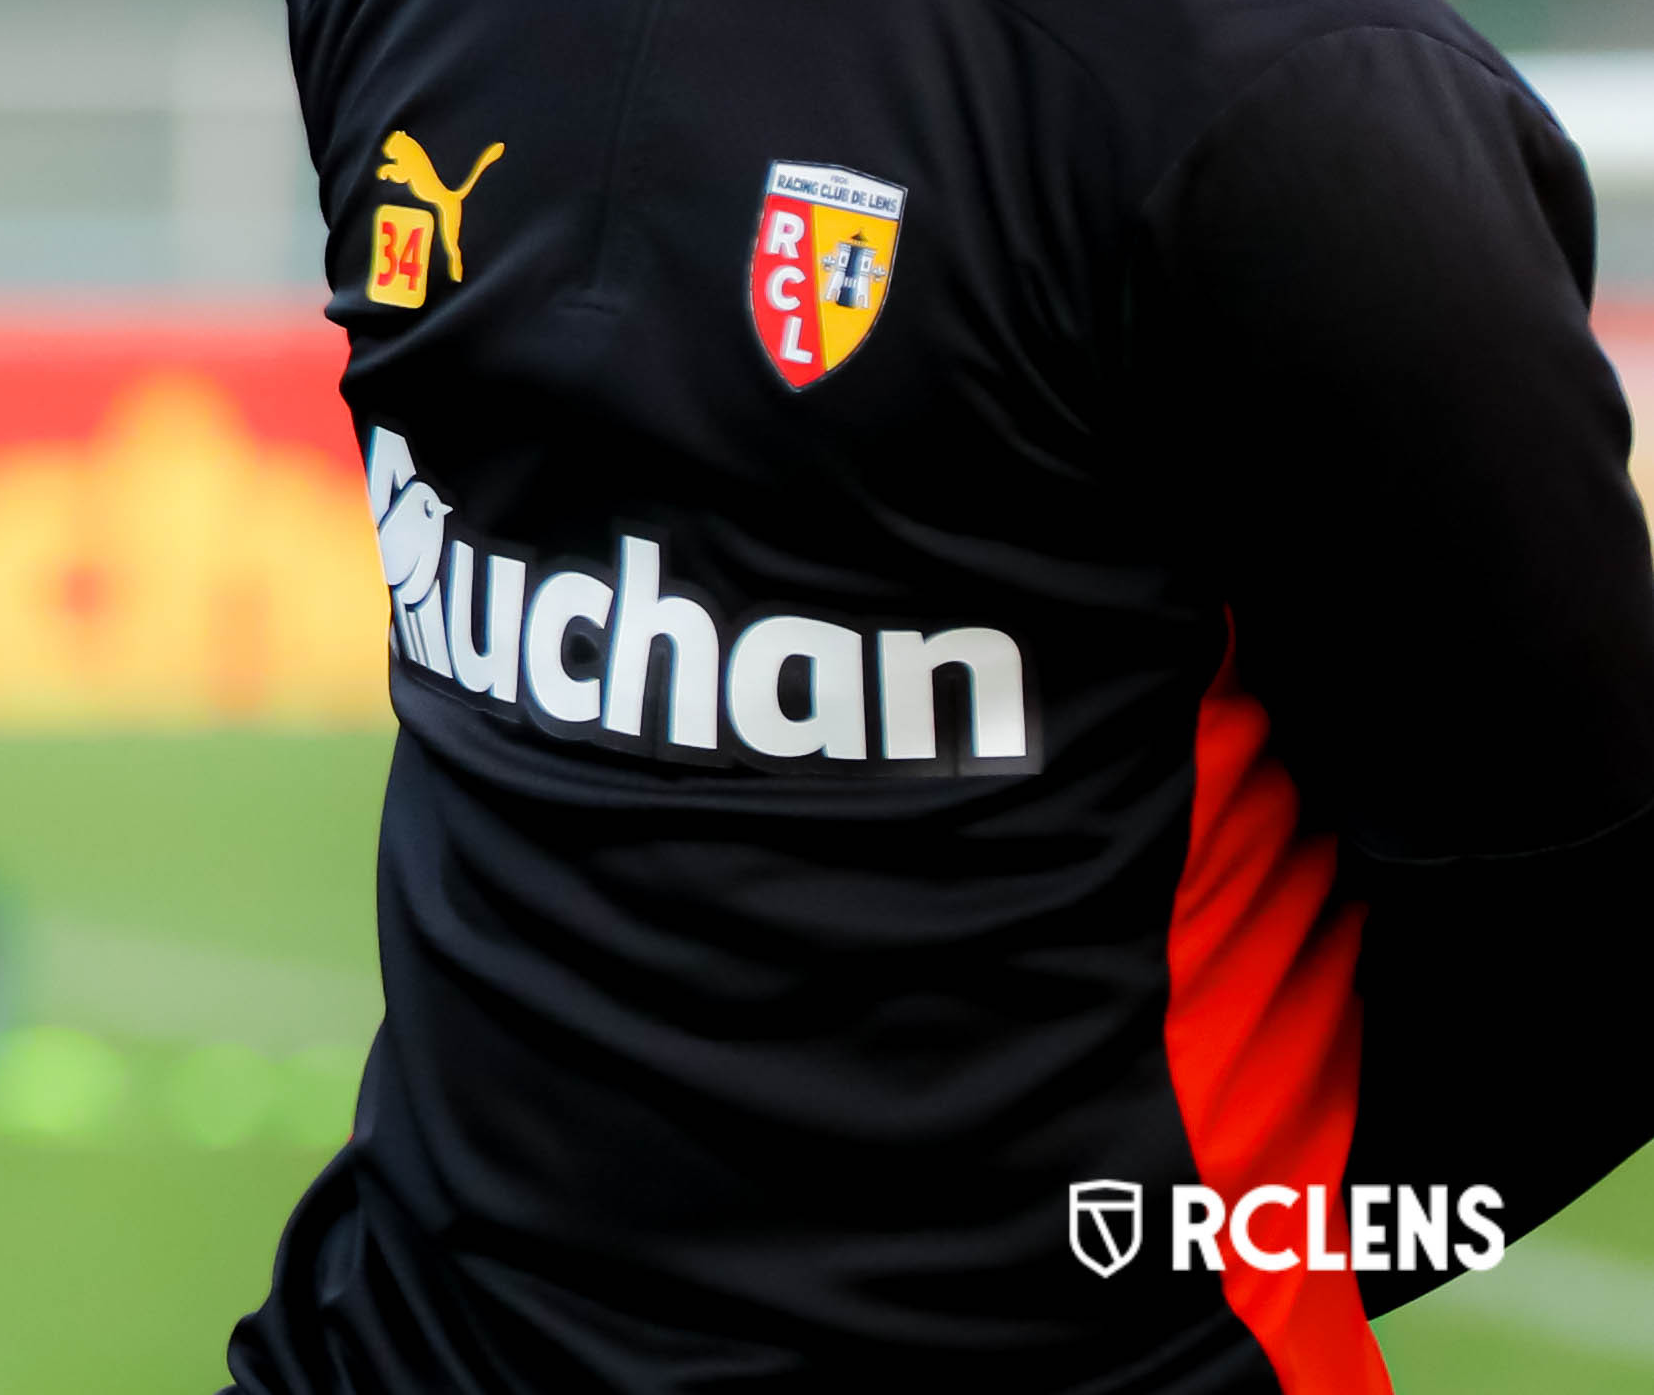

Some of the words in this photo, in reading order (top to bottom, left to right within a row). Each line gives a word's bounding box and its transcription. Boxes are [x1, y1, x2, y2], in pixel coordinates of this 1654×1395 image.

[776, 174, 819, 197] RACING
[820, 184, 851, 202] CLUB
[851, 190, 867, 206] DE
[868, 193, 899, 213] LENS
[377, 220, 424, 291] 34
[766, 210, 813, 364] RCL
[366, 425, 1028, 761] Auchan
